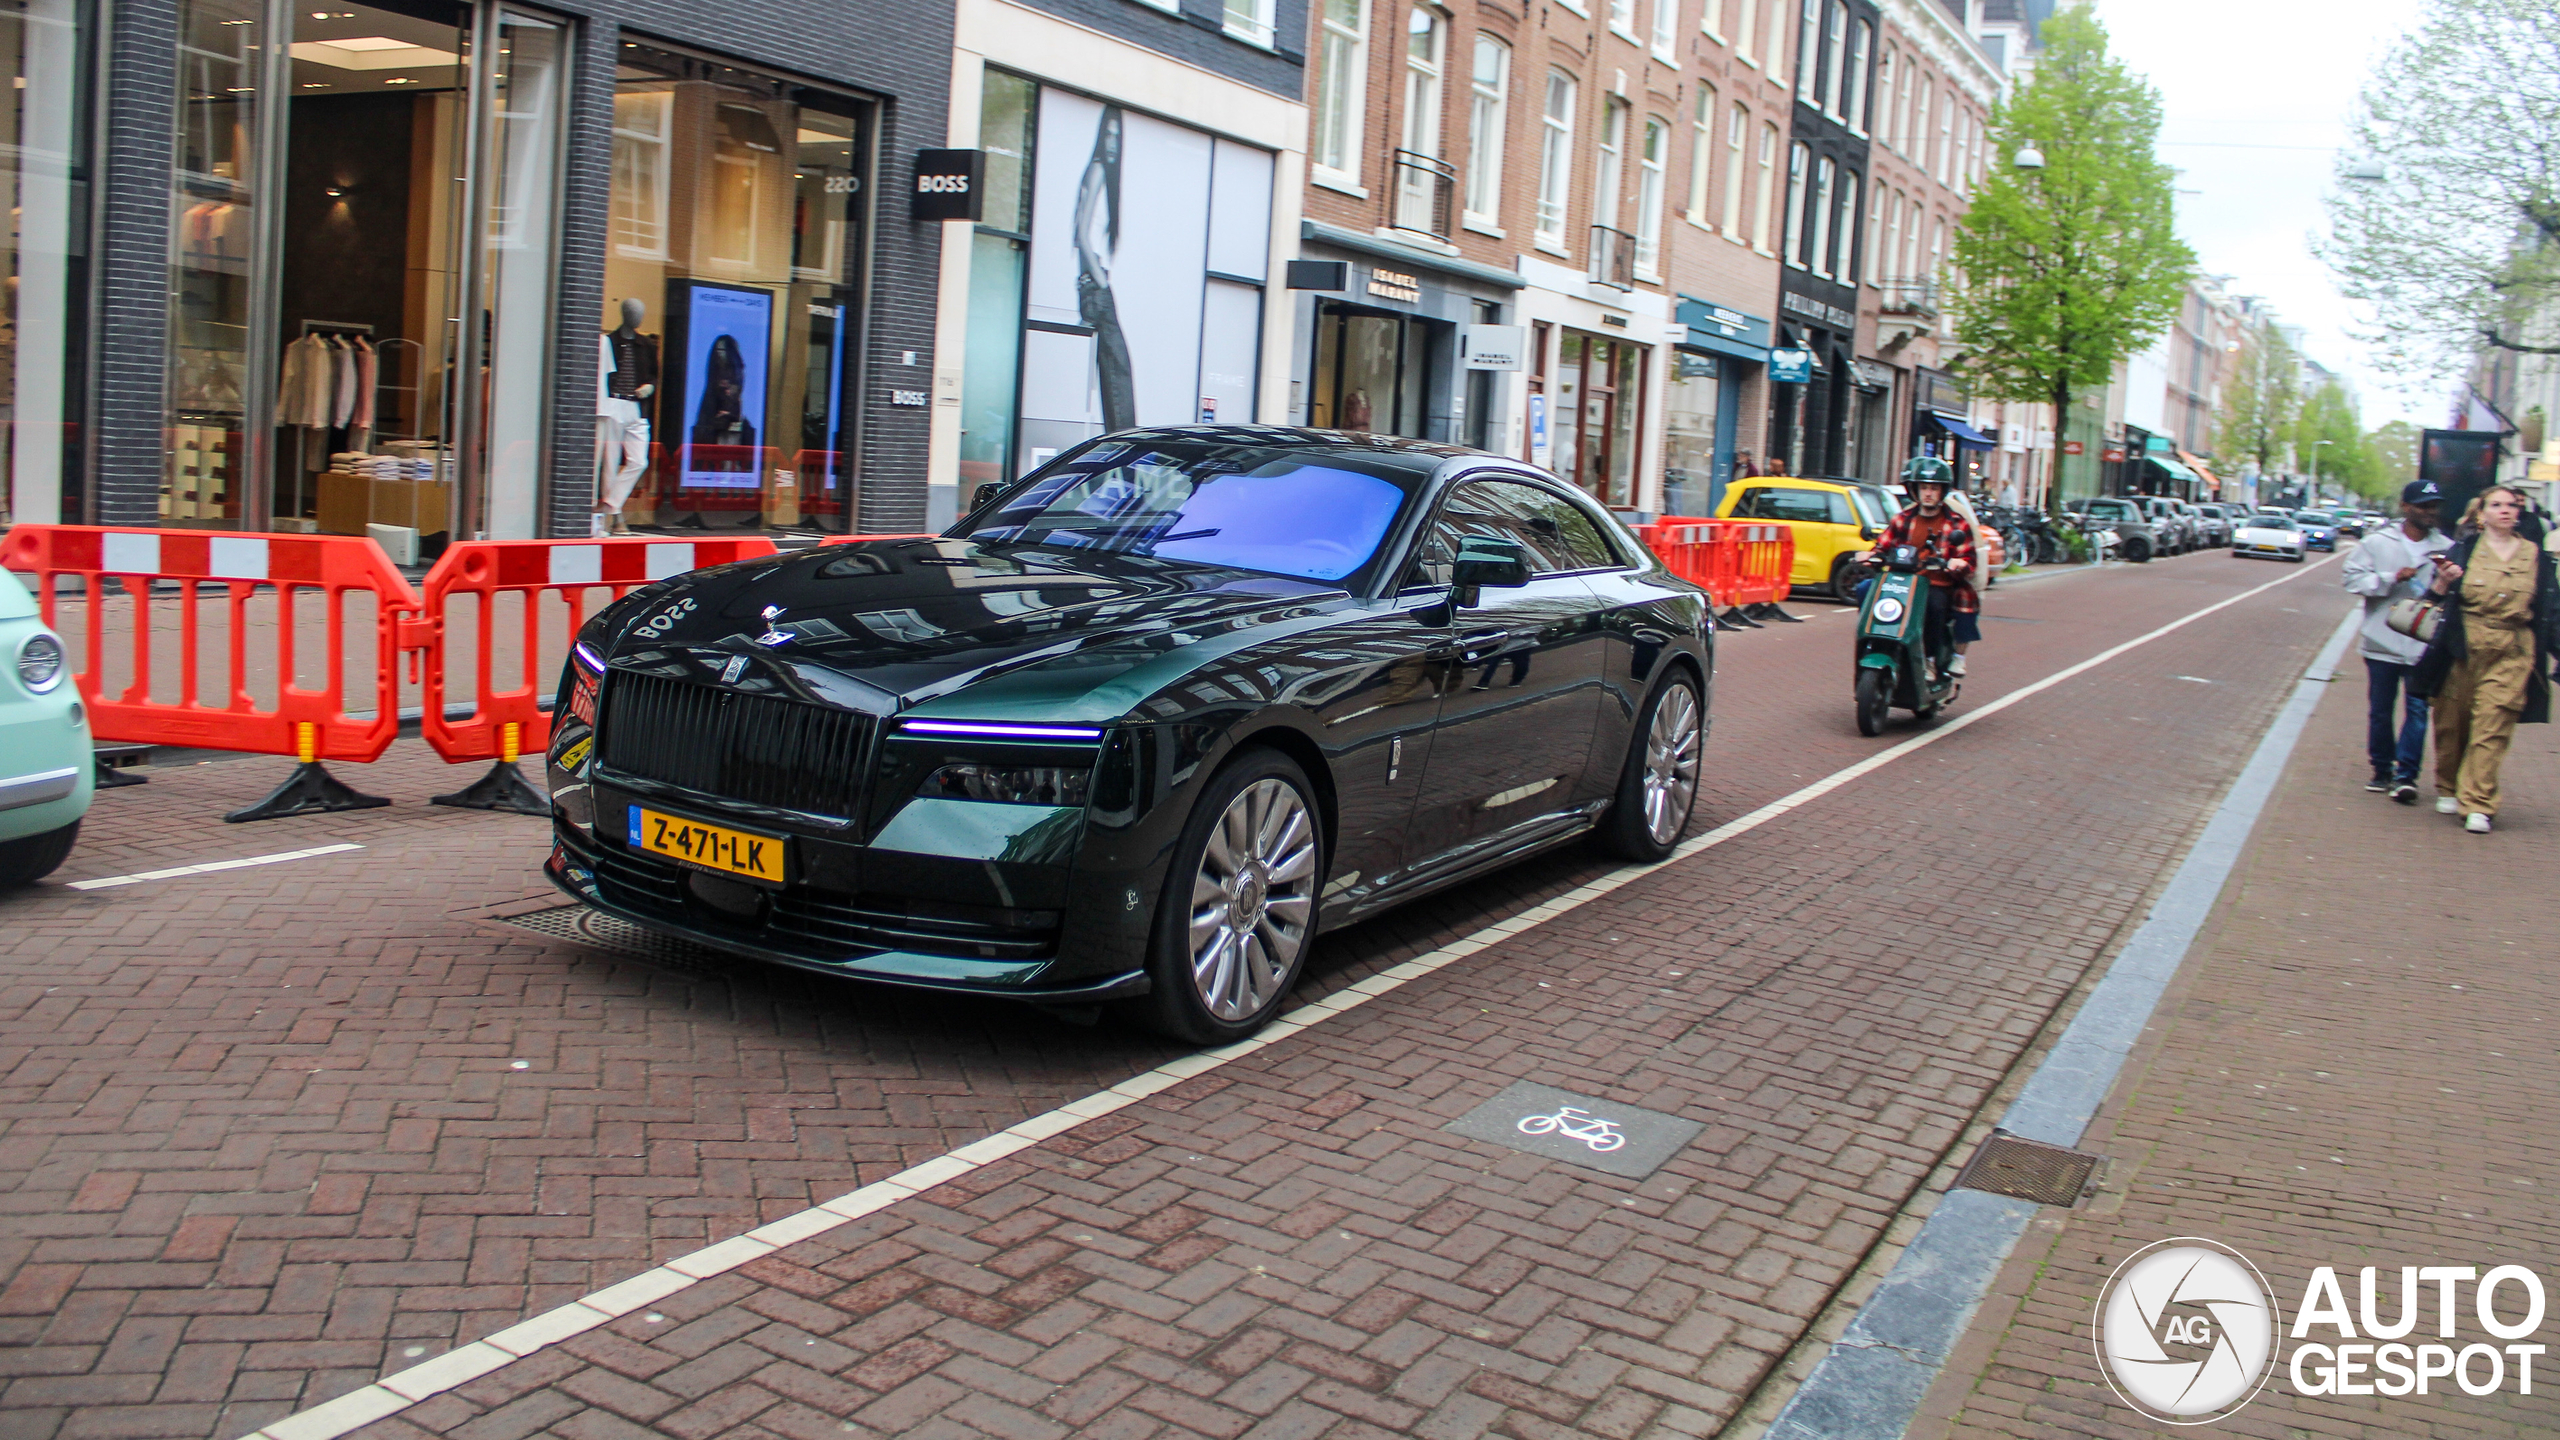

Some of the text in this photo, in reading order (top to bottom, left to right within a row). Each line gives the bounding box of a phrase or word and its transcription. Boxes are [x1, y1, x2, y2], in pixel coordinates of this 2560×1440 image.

[824, 176, 860, 194] 220
[918, 175, 969, 193] BOSS
[1373, 268, 1419, 289] ISABEL
[1368, 282, 1422, 304] MARANT
[892, 390, 926, 406] BOSS
[630, 829, 641, 841] NL
[653, 817, 766, 873] Z-471-LK
